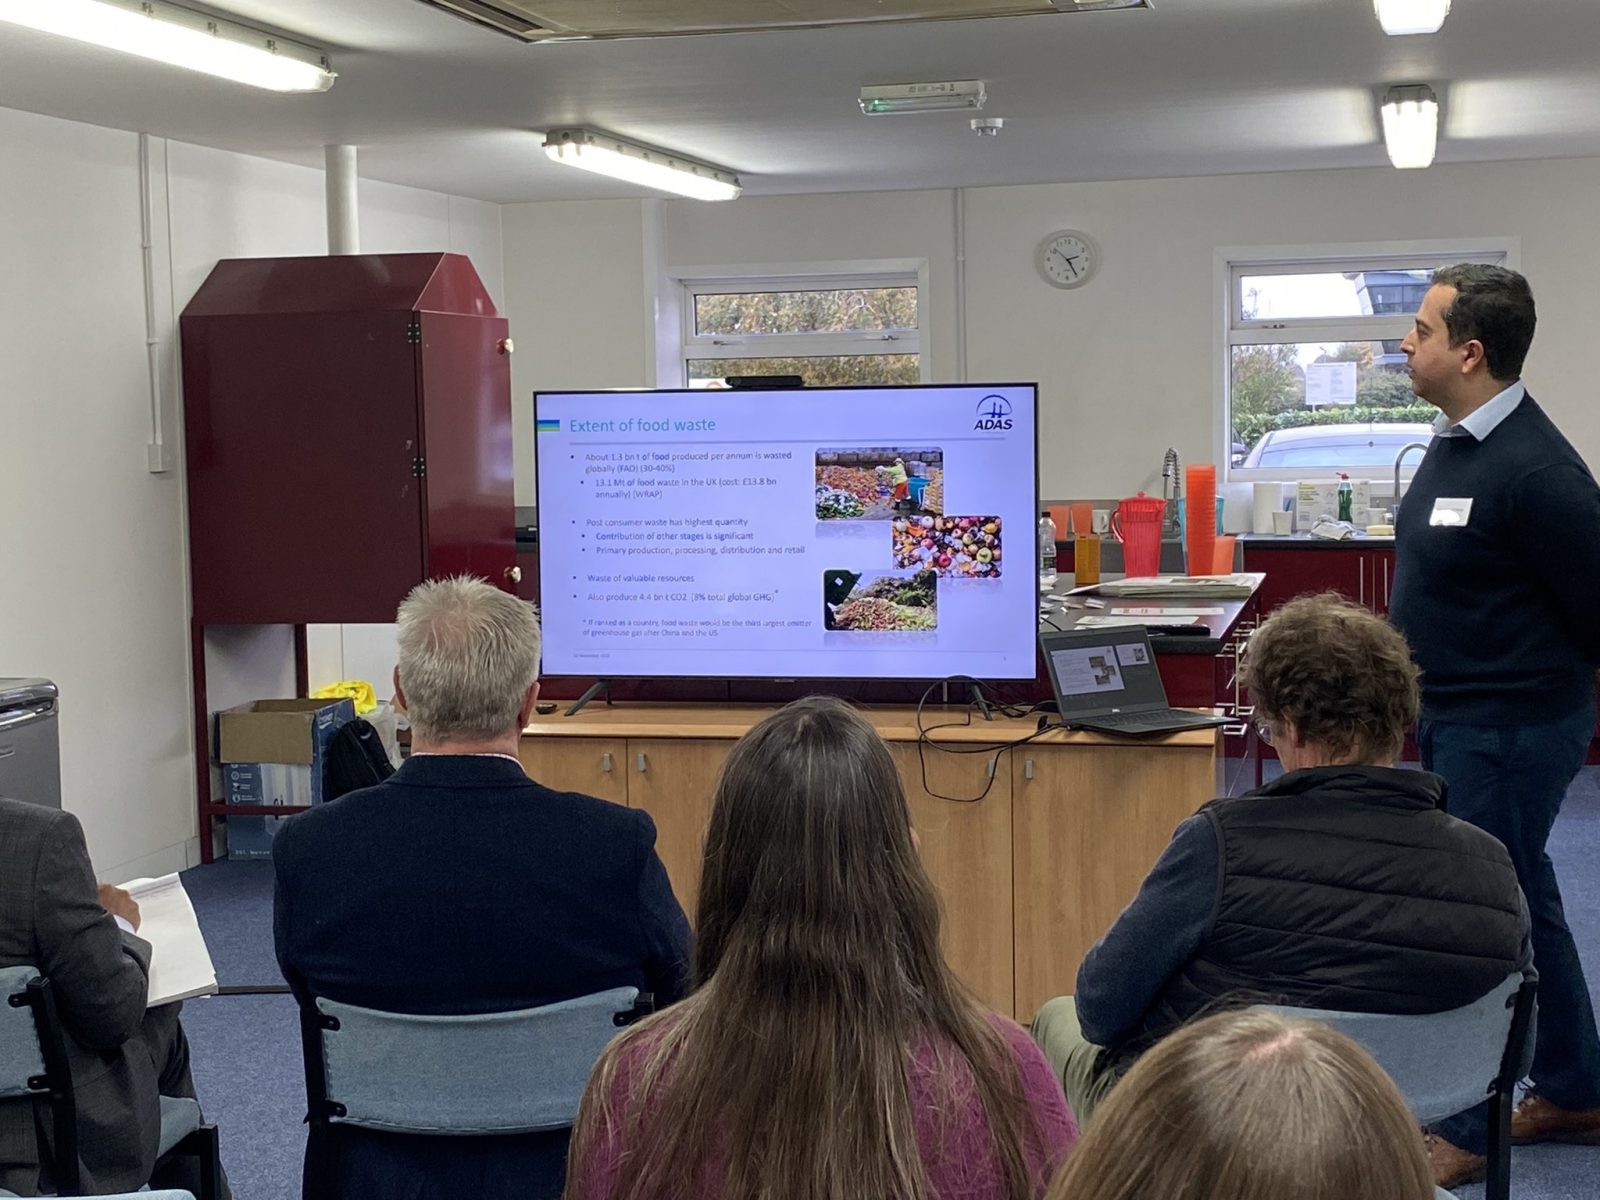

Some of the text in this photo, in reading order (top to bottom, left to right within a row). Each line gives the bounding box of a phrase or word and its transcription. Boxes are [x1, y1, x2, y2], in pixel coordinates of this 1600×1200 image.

[570, 418, 716, 432] Extent of food waste
[974, 419, 1013, 430] ADAS
[642, 452, 650, 460] of
[652, 452, 670, 460] food
[672, 452, 708, 462] produced
[764, 452, 792, 460] wasted
[585, 465, 614, 474] globally
[640, 464, 676, 473] (30-40%)
[690, 478, 704, 486] the
[706, 478, 718, 486] UK
[742, 478, 764, 486] £13.8
[766, 478, 776, 486] bn
[669, 518, 682, 526] has
[684, 518, 713, 528] highest
[715, 518, 748, 528] quantity
[596, 532, 645, 540] Contribution
[646, 532, 655, 540] of
[680, 533, 704, 541] stages
[714, 531, 754, 541] significant
[596, 545, 805, 556] Primary production, processing, distribution and retail
[587, 574, 612, 582] Waste
[613, 574, 622, 582] of
[624, 574, 656, 582] valuable
[606, 592, 638, 602] produce
[654, 592, 664, 600] bn
[708, 592, 726, 600] total
[728, 592, 752, 602] global
